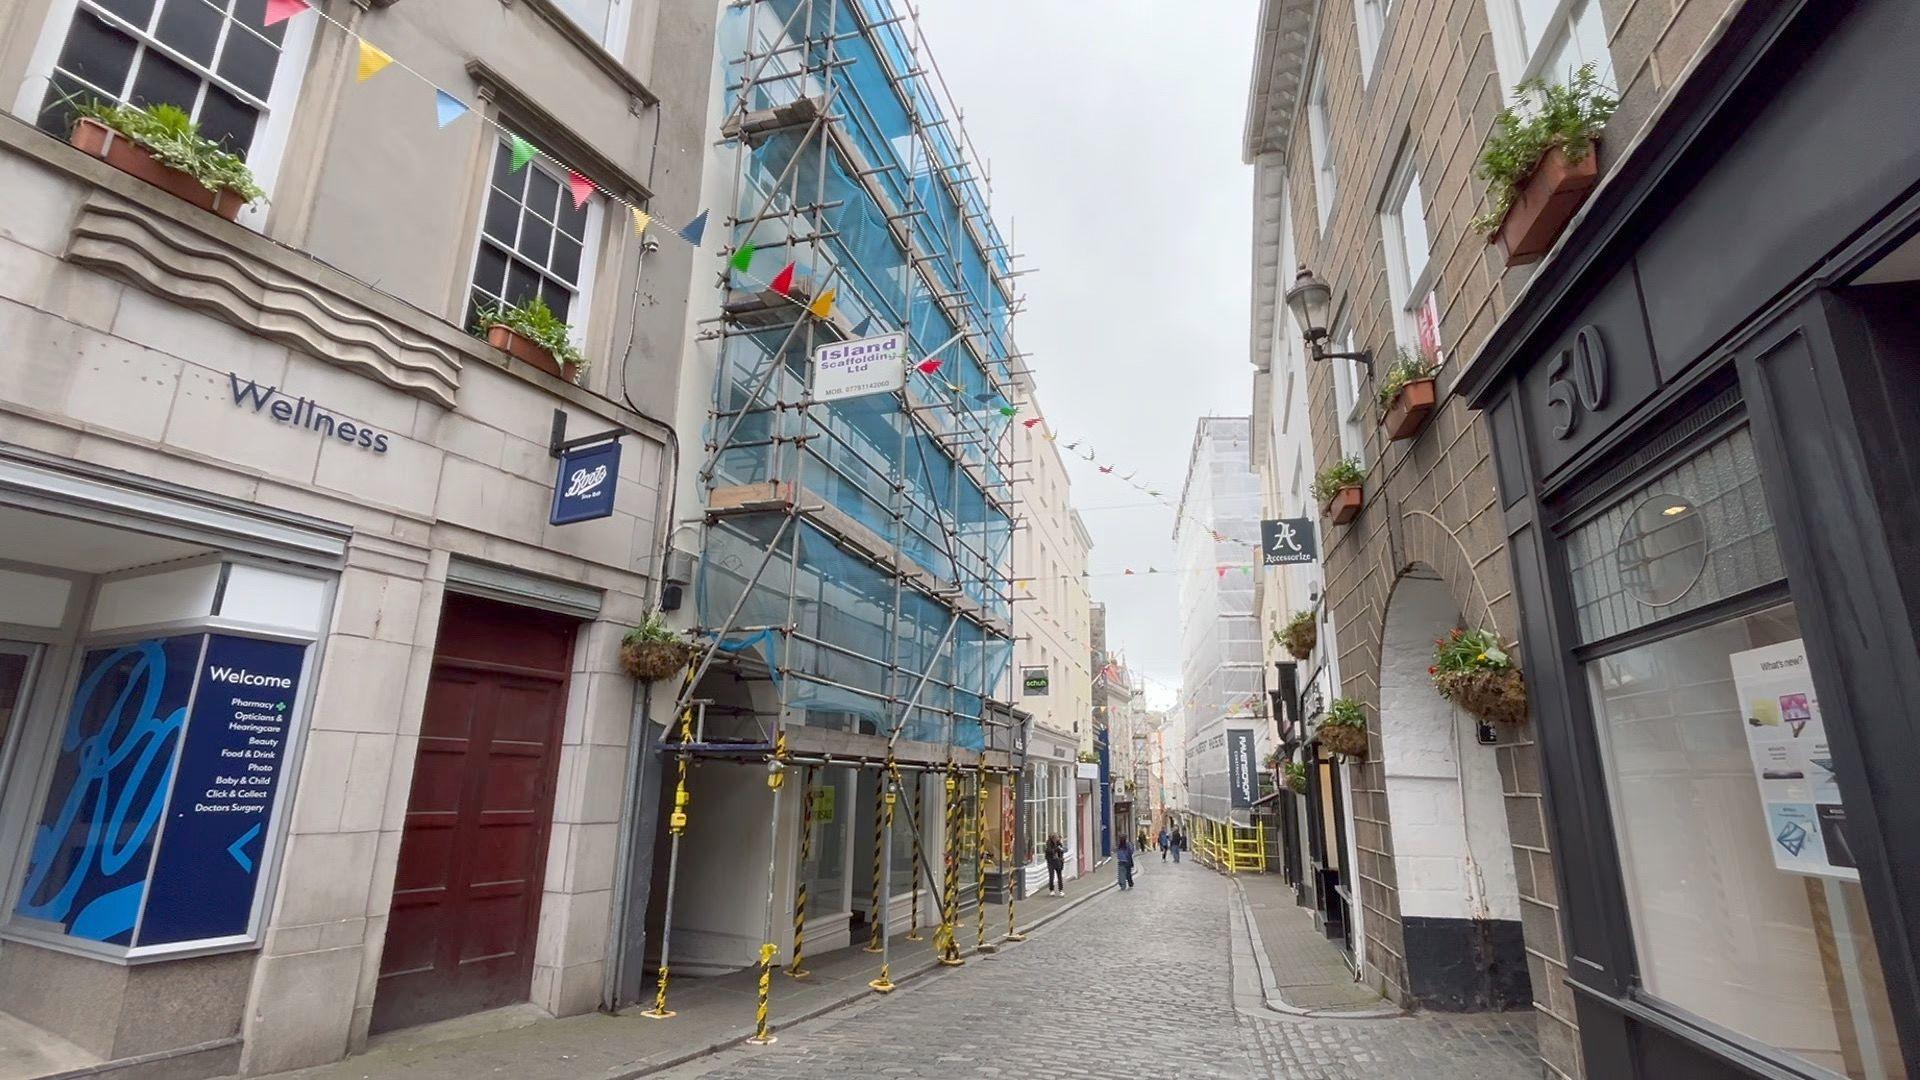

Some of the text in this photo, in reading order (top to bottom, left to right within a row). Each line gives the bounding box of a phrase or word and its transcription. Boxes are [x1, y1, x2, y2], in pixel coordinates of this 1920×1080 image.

[821, 338, 897, 361] Island
[821, 352, 896, 370] Scaffolding
[847, 364, 868, 374] Ltd
[1547, 324, 1609, 441] 50
[229, 371, 389, 453] Wellness
[564, 464, 607, 498] Boots
[1266, 553, 1311, 563] Accessorize
[210, 666, 291, 688] Welcome
[231, 698, 274, 710] Pharmacy
[234, 711, 283, 722] Opticians &
[229, 722, 281, 733] Hearingcare
[248, 736, 279, 748] Beauty
[221, 748, 275, 759] Food & Drink
[248, 763, 273, 772] Photo
[215, 775, 271, 786] Baby & Child
[206, 789, 267, 798] Click & Collect
[195, 803, 265, 814] Doctors Surgery
